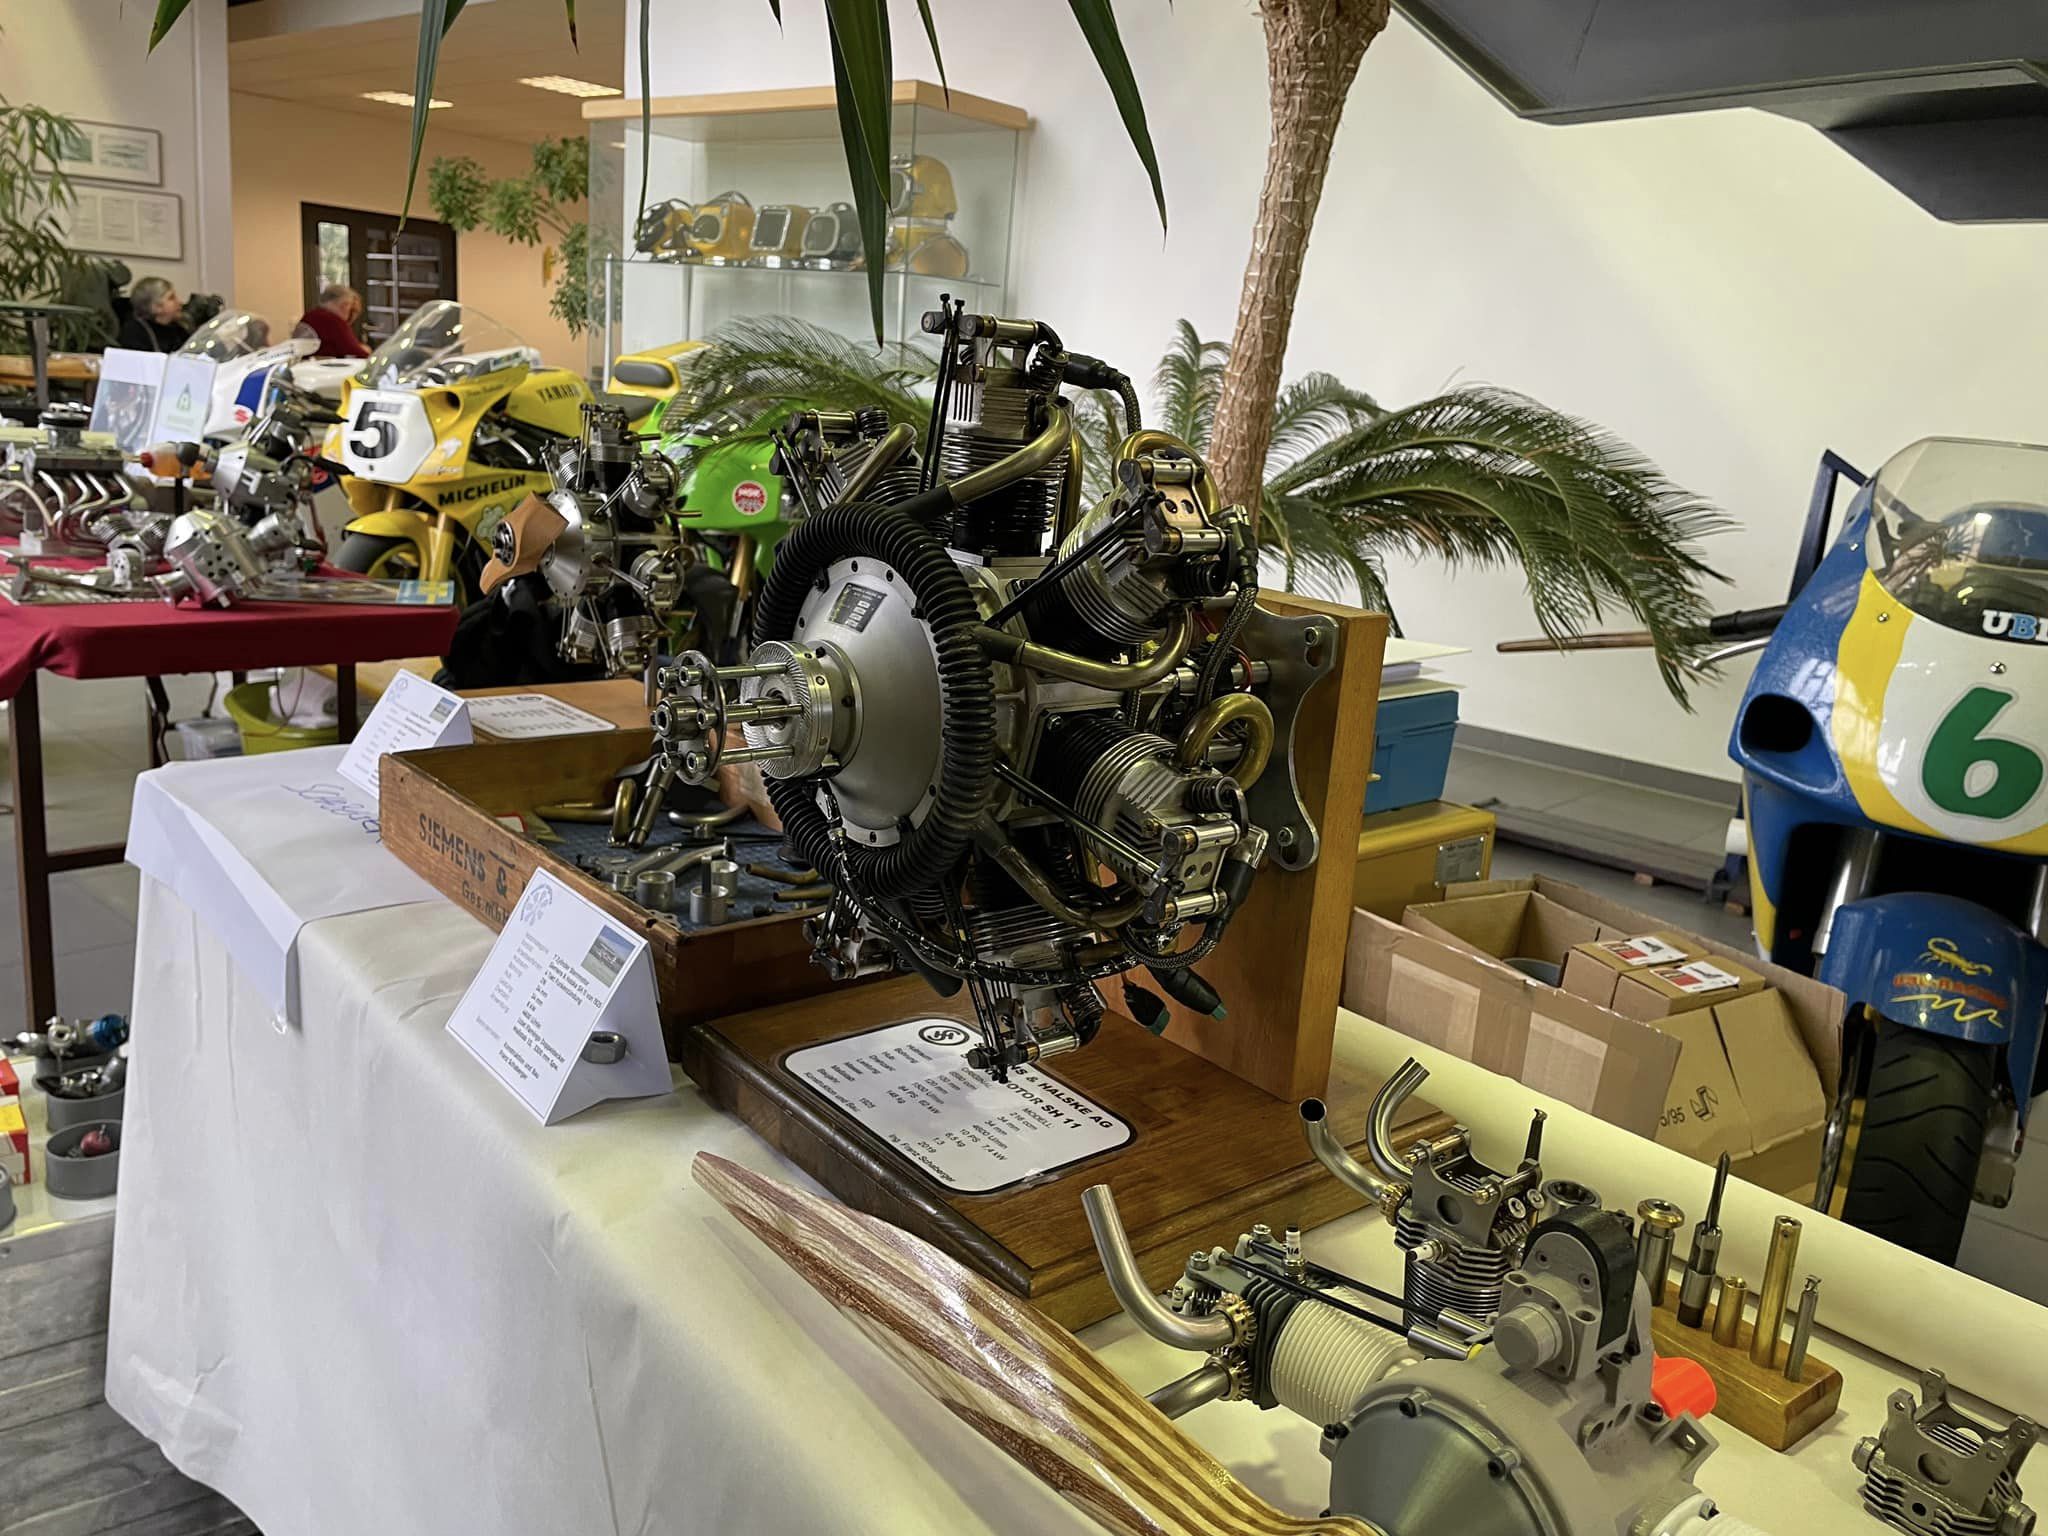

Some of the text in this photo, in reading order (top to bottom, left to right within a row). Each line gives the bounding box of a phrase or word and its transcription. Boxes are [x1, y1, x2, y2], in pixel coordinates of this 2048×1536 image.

[536, 383, 582, 404] YAMAHA
[350, 401, 403, 459] 5
[437, 474, 526, 506] MICHELIN
[1922, 687, 2043, 820] 6
[419, 812, 486, 881] SIEMENS
[495, 866, 508, 899] &
[1038, 1083, 1092, 1114] HALSKE
[1089, 1115, 1114, 1128] AG
[1041, 1104, 1064, 1117] SH
[1062, 1118, 1082, 1129] 11
[918, 1141, 937, 1153] 2019
